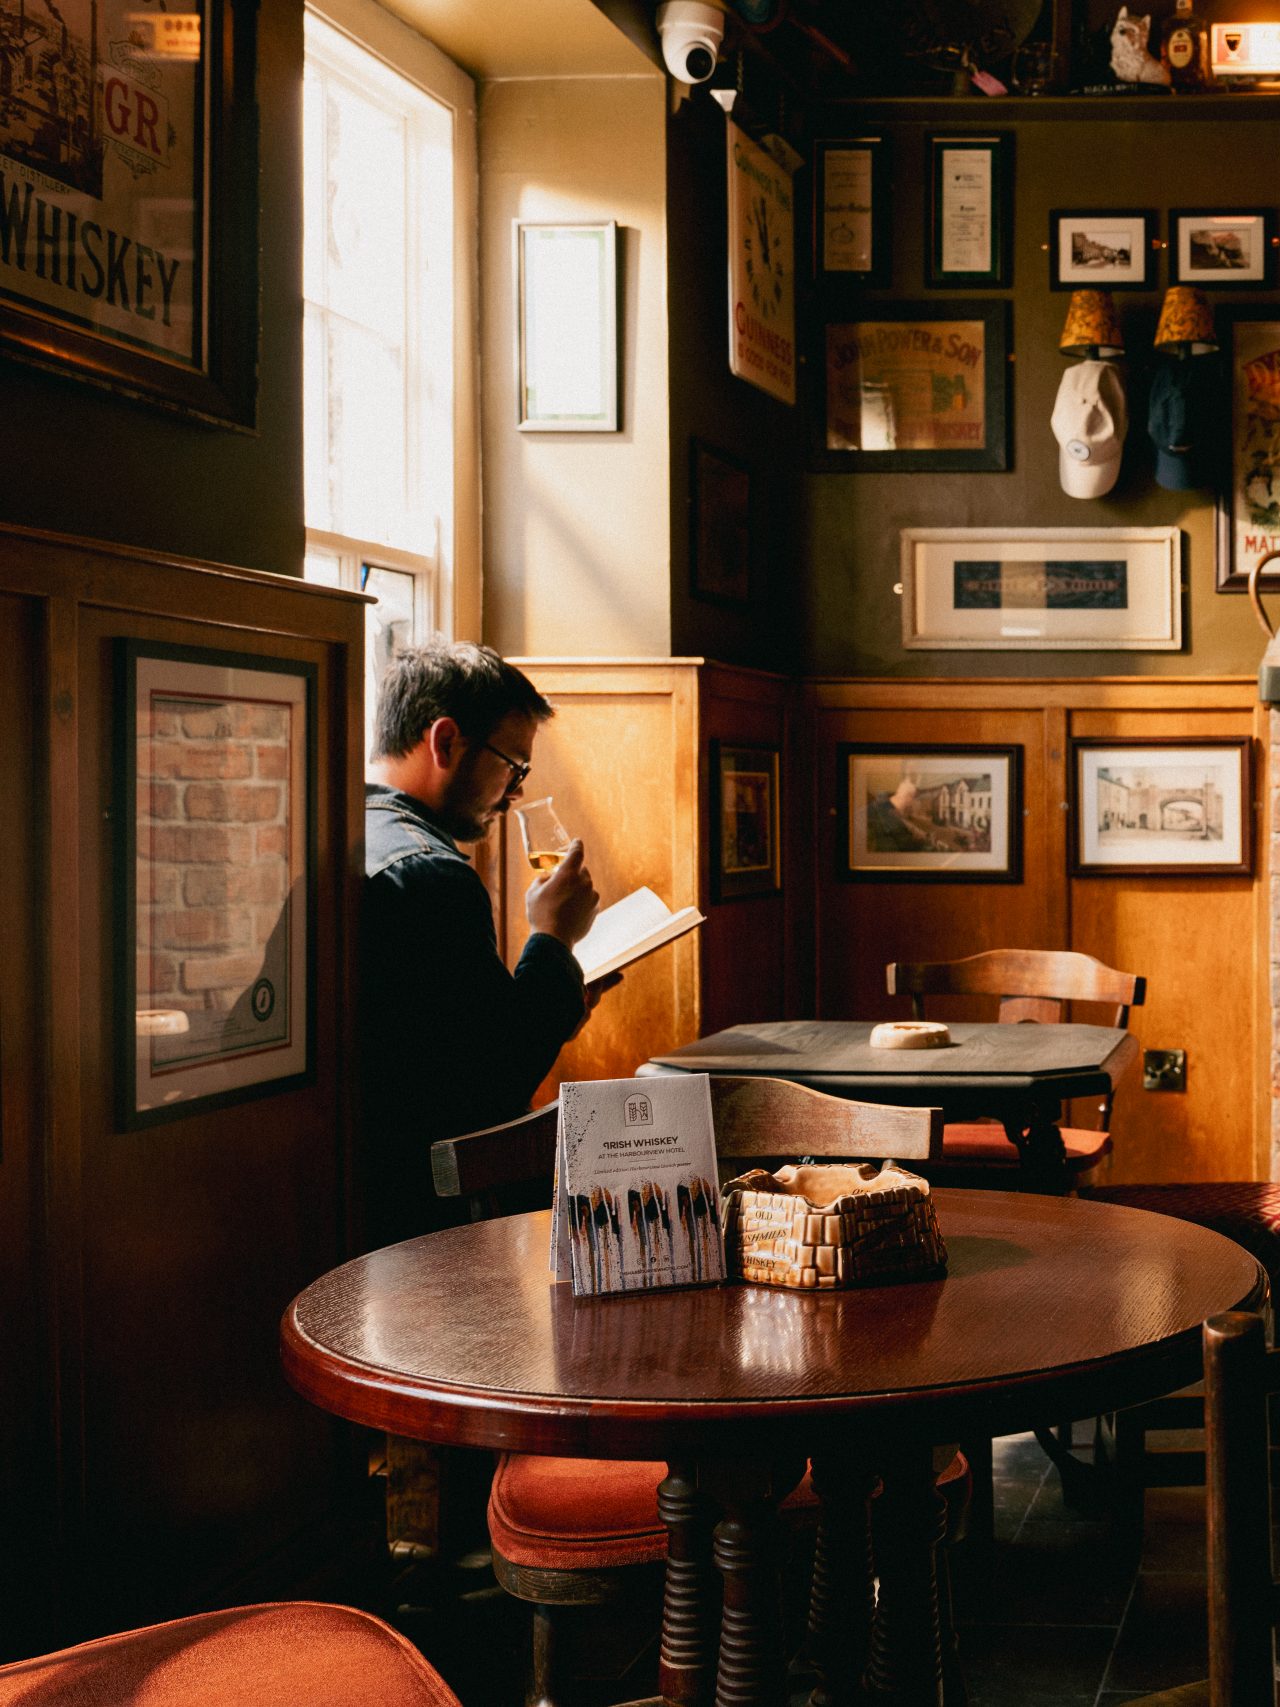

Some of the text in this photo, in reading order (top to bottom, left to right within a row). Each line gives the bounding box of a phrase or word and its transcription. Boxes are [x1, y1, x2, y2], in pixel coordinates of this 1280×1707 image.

[105, 77, 162, 156] GR
[20, 169, 71, 195] DISTILLERY
[0, 170, 181, 328] WHISKEY
[736, 302, 793, 366] GUINNESS
[877, 329, 932, 353] POWER
[945, 333, 982, 368] SON
[620, 1149, 665, 1158] HARBOURVIEW
[634, 1136, 679, 1148] WHISKEY
[755, 1210, 773, 1221] OLD
[743, 1229, 787, 1243] SHMILLS
